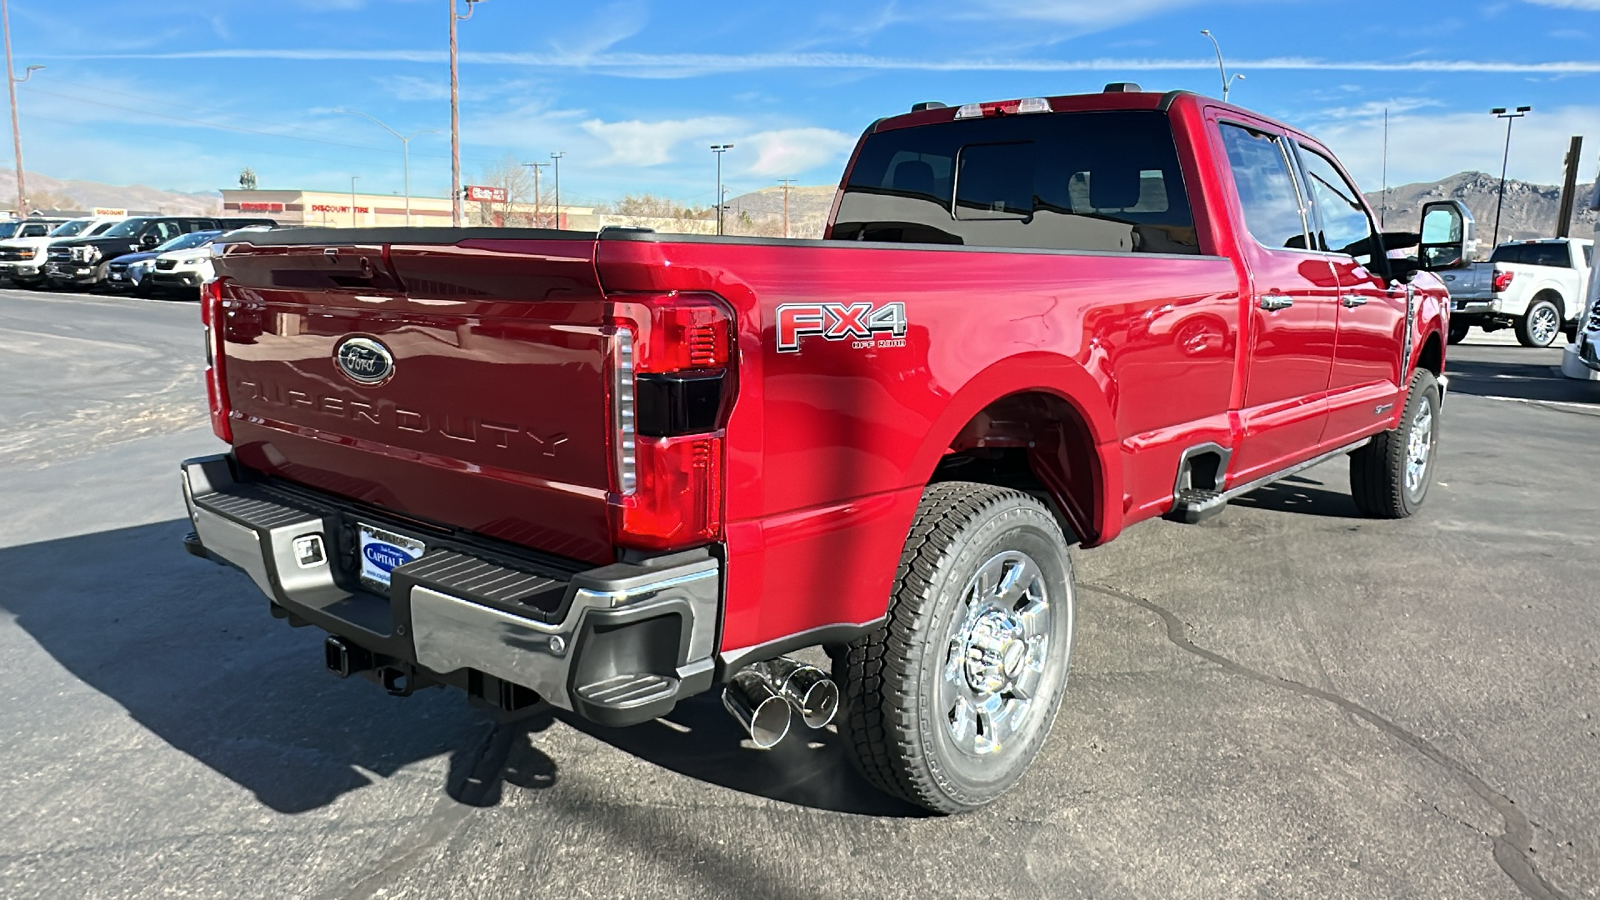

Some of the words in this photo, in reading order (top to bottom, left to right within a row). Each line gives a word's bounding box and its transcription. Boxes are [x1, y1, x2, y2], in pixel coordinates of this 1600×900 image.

[311, 204, 350, 213] DISCOUNT
[776, 302, 907, 353] FX4
[346, 346, 377, 374] Ford
[237, 380, 381, 425] SUPER
[395, 408, 569, 457] DUTY
[366, 547, 398, 567] CAPITAL
